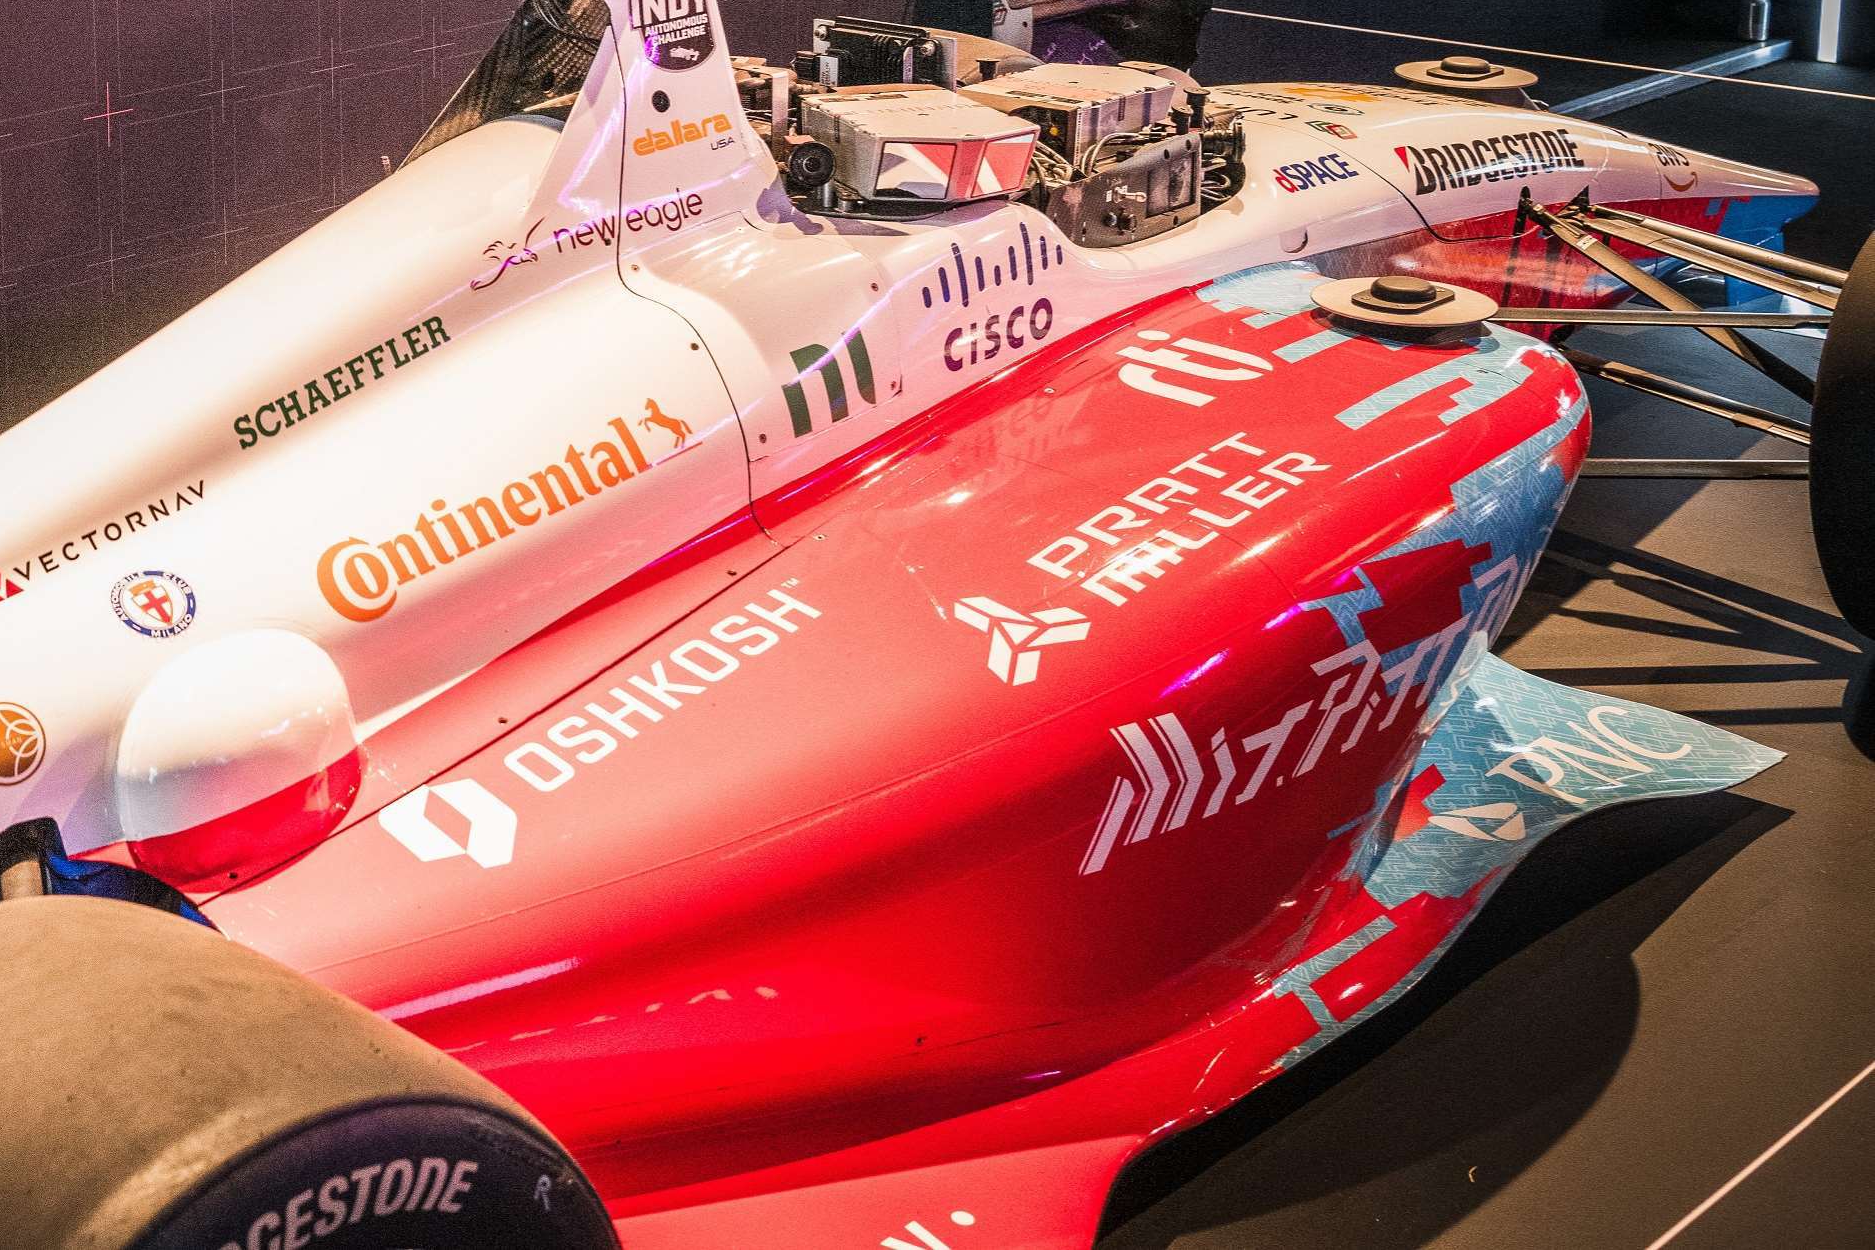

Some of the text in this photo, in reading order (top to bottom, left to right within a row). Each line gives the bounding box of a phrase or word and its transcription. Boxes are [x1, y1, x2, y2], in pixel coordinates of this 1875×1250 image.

[645, 13, 709, 37] AUTONOMOUS
[652, 25, 707, 46] CHALLENGE
[632, 113, 733, 157] dallara
[710, 136, 736, 152] USA
[1405, 129, 1585, 196] BRIDGESTONE
[1273, 153, 1360, 194] dSPACE
[552, 188, 703, 253] new eagle
[233, 315, 452, 450] SCHAEFFLER
[13, 480, 208, 582] VECTORNAV
[316, 417, 654, 623] Continental
[1027, 432, 1268, 578] PRATT
[1082, 450, 1331, 607] MILLER
[1486, 704, 1695, 806] PNC
